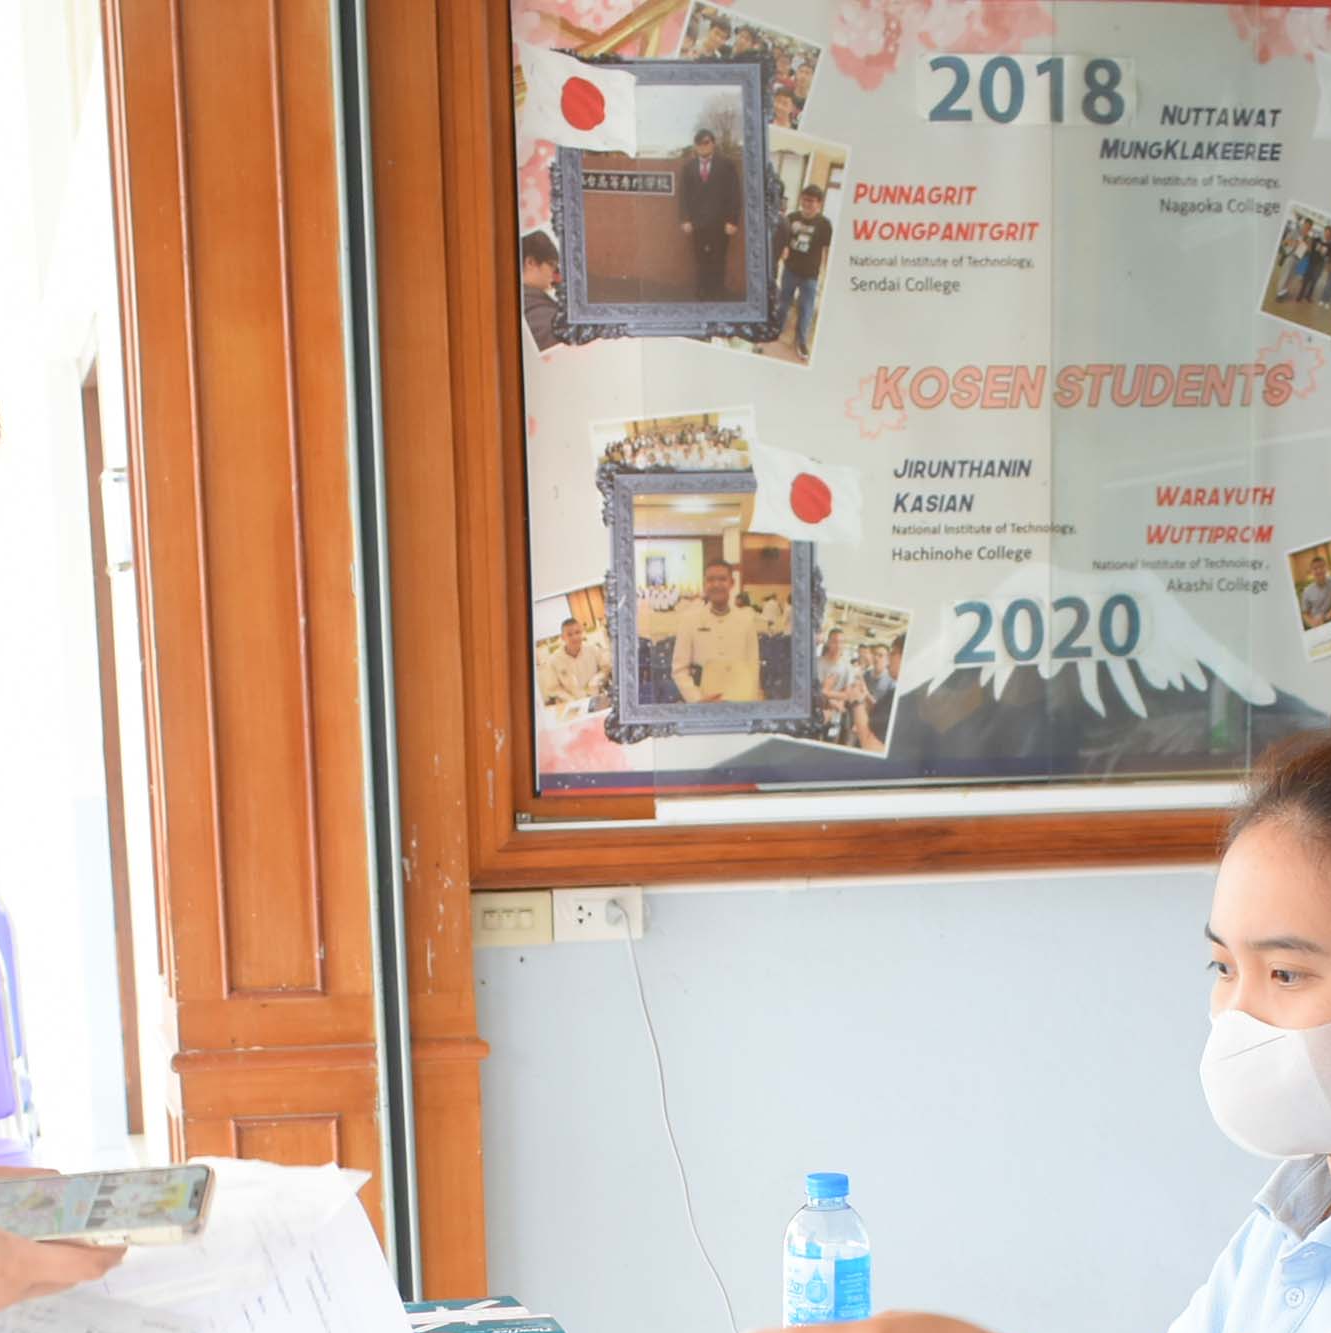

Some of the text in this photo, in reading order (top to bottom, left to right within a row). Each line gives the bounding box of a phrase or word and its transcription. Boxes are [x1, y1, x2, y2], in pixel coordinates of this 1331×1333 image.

[928, 55, 1125, 125] 2018
[1160, 105, 1282, 127] NUTTAWAT
[1102, 174, 1149, 186] National
[1152, 174, 1198, 187] Institute
[1201, 174, 1214, 186] of
[853, 183, 977, 205] PUNNAGRIT
[1160, 198, 1281, 217] Nagaoka College
[849, 256, 897, 267] National
[901, 256, 948, 267] Institute
[952, 256, 964, 267] of
[850, 276, 961, 295] Sendai College
[872, 363, 1295, 410] KOSEN STUDENTS
[893, 458, 1033, 479] JIRUNTHANIN
[893, 492, 975, 513] KASIAN
[1156, 485, 1277, 507] WARAYUTH
[892, 524, 941, 536] National
[944, 523, 992, 535] Institute
[995, 523, 1008, 535] of
[892, 546, 1033, 563] Hachinohe College
[1092, 559, 1139, 571] National
[1142, 559, 1187, 570] Institute
[1190, 557, 1202, 570] of
[1166, 577, 1269, 594] Akashi College
[953, 594, 1141, 665] 2020
